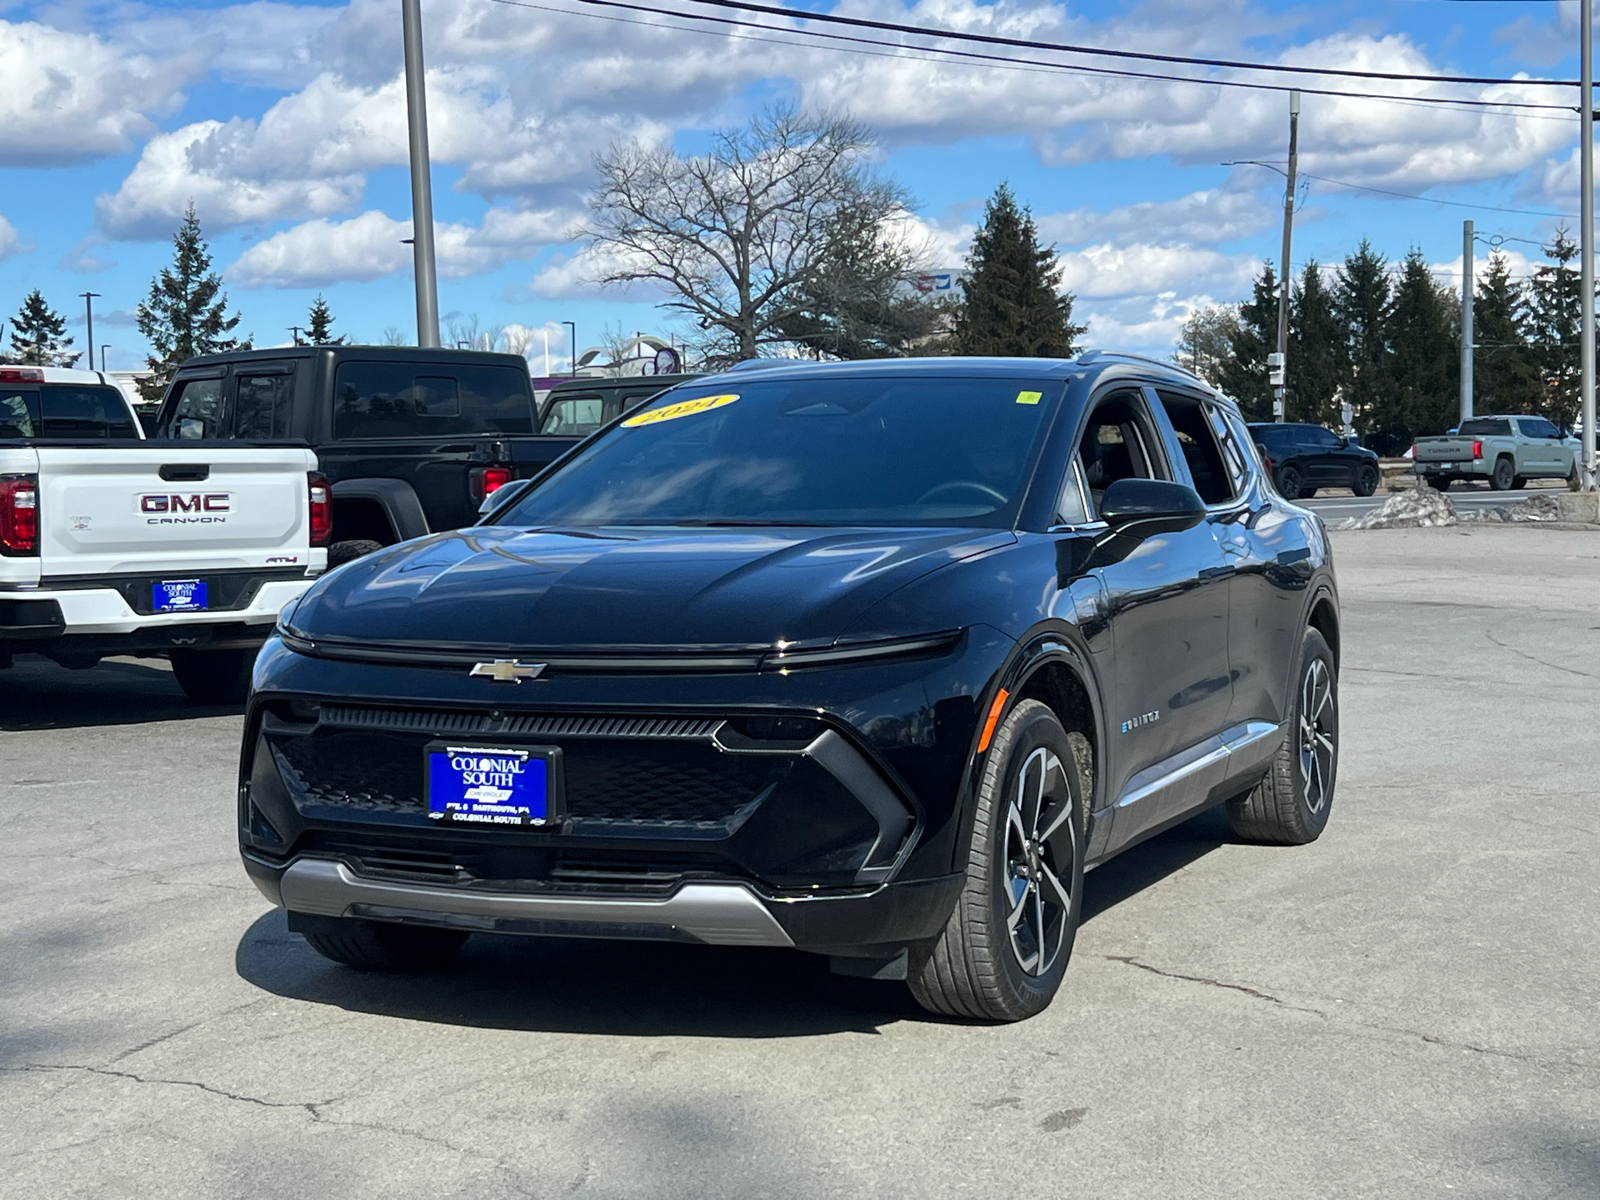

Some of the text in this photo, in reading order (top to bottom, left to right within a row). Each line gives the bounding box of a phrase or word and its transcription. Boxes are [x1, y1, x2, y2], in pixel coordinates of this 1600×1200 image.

[639, 397, 721, 424] 2024
[140, 494, 230, 514] GMC
[147, 517, 226, 525] CANYON
[162, 583, 198, 591] COLONIAL
[1121, 710, 1159, 733] EQUINOX
[451, 757, 525, 774] COLONIAL
[462, 772, 514, 787] SOUTH
[469, 790, 507, 798] CHEVROLET
[452, 813, 522, 824] COLONIAL SOUTH
